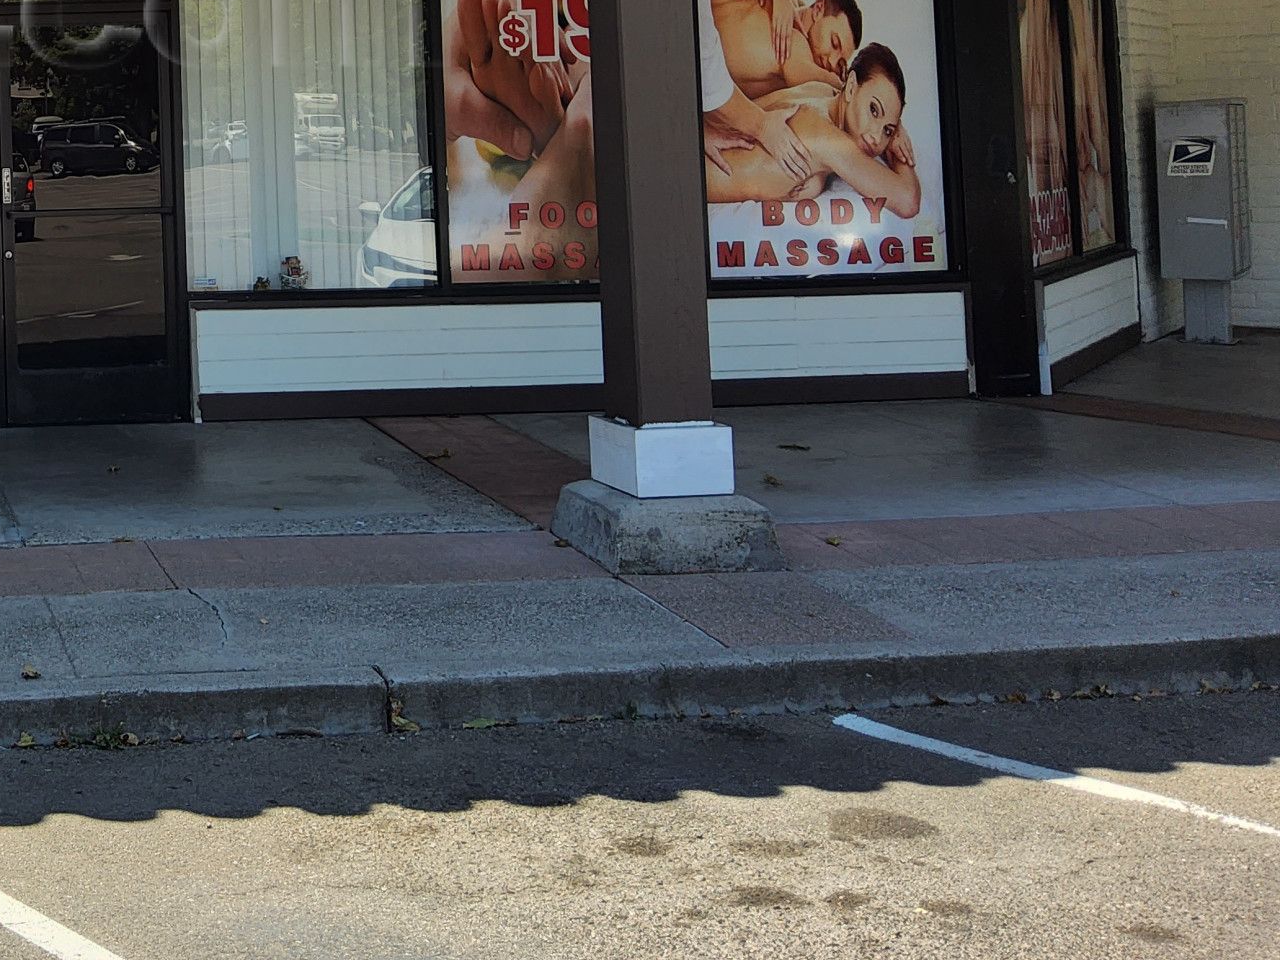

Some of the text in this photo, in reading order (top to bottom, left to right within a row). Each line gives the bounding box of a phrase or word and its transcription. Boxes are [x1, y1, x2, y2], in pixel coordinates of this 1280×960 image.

[509, 201, 597, 229] FOO
[761, 197, 887, 227] BODY
[461, 241, 599, 271] MASS
[716, 236, 935, 268] MASSAGE
